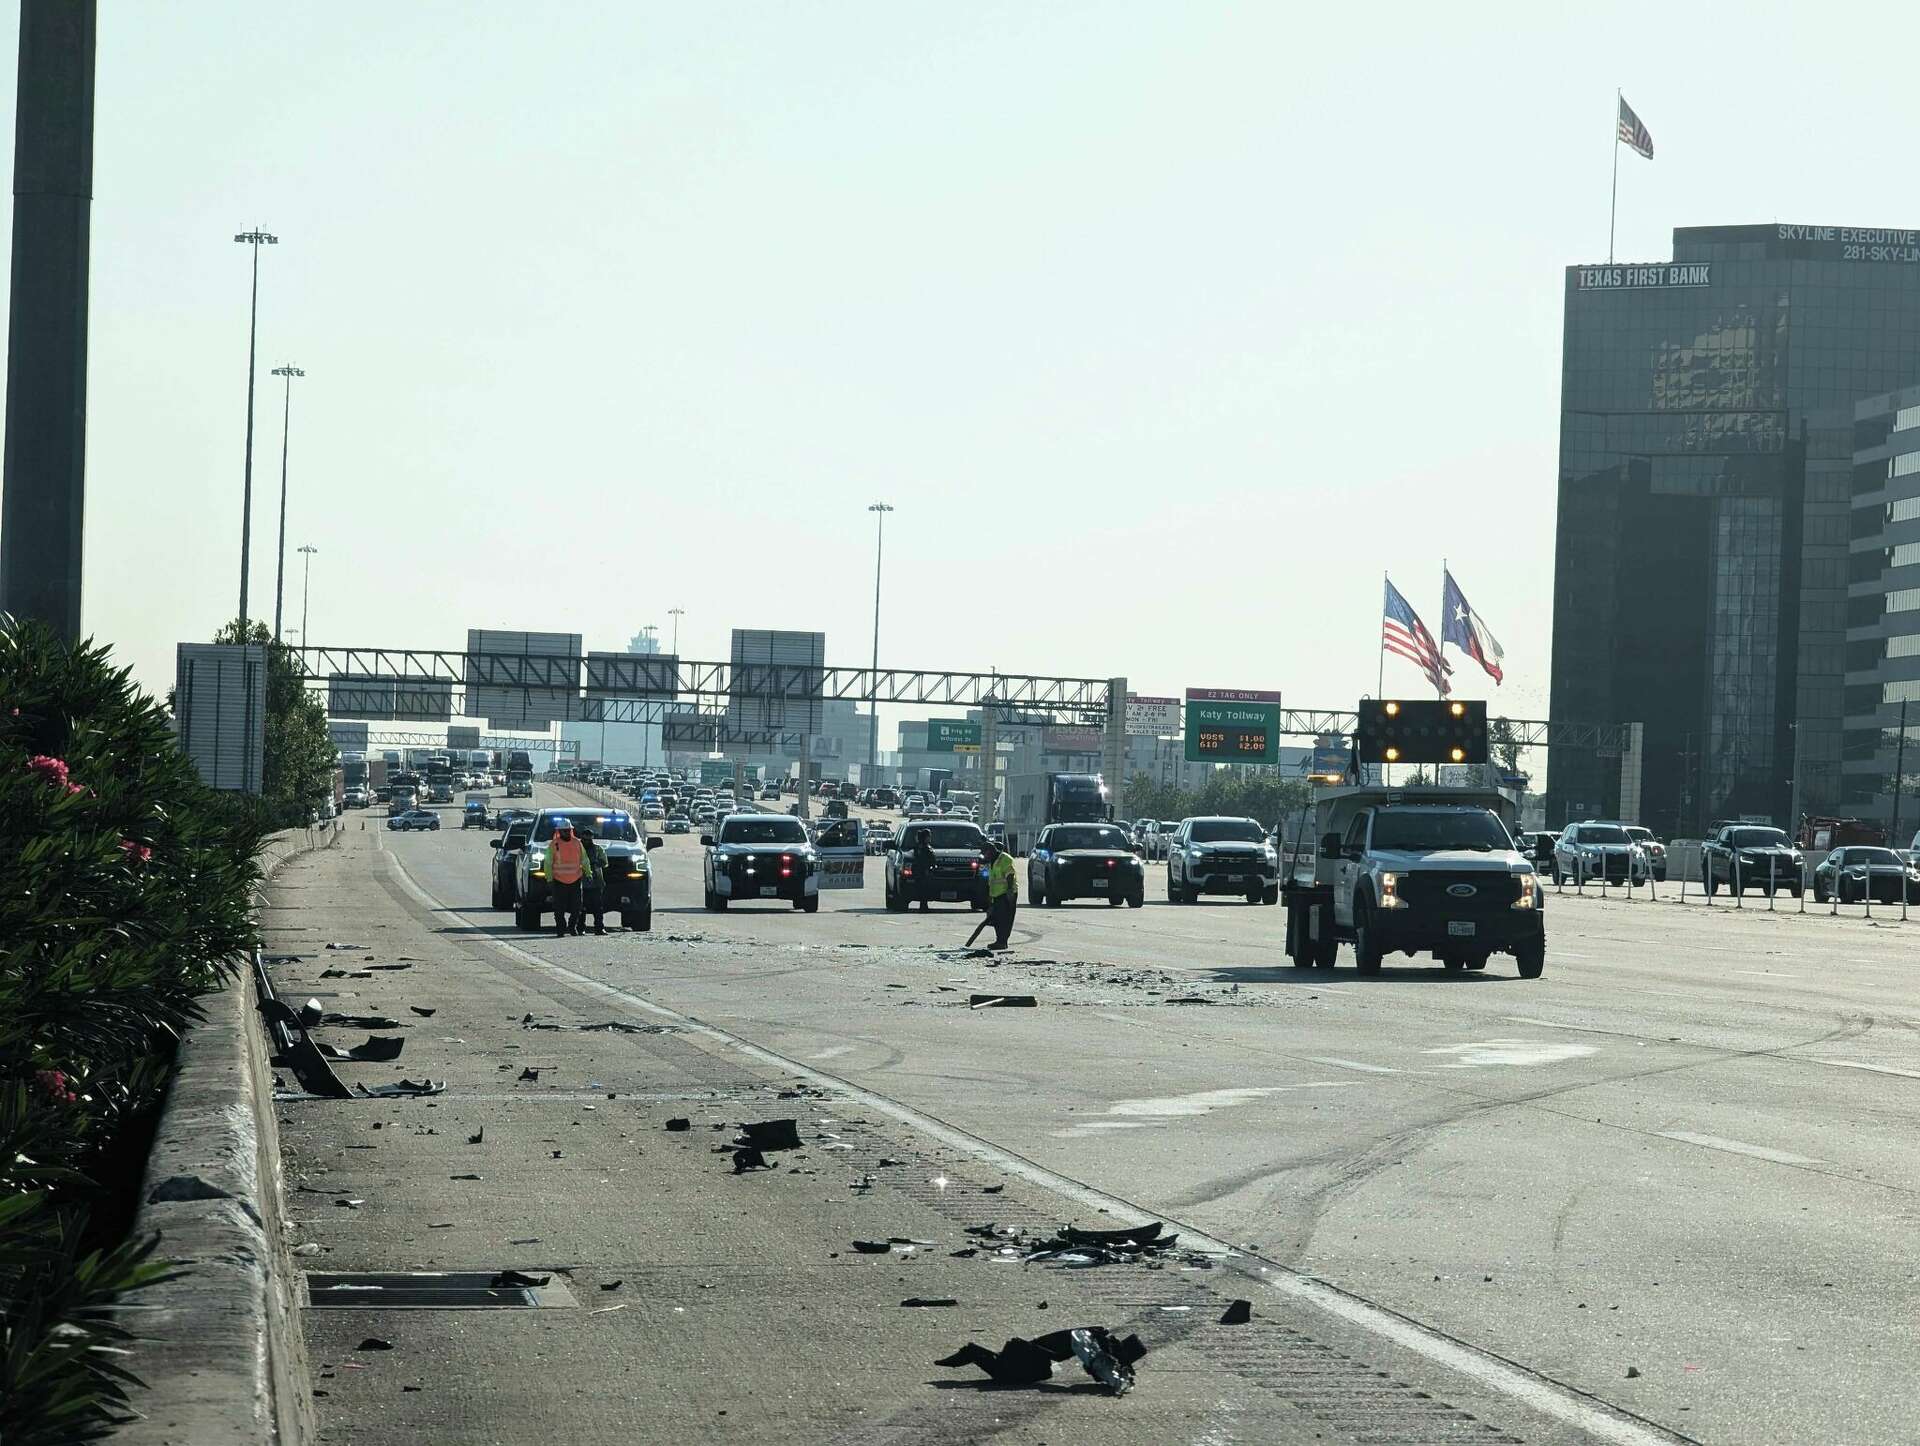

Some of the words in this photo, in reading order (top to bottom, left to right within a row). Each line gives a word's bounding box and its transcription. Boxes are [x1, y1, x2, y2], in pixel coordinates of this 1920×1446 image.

[1778, 225, 1835, 241] SKYLINE
[1841, 228, 1915, 245] EXECUTIVE
[1579, 268, 1622, 288] TEXAS
[1626, 268, 1665, 287] FIRST
[1669, 266, 1710, 285] BANK
[1200, 710, 1222, 721] Katy
[1227, 711, 1266, 722] Tollway
